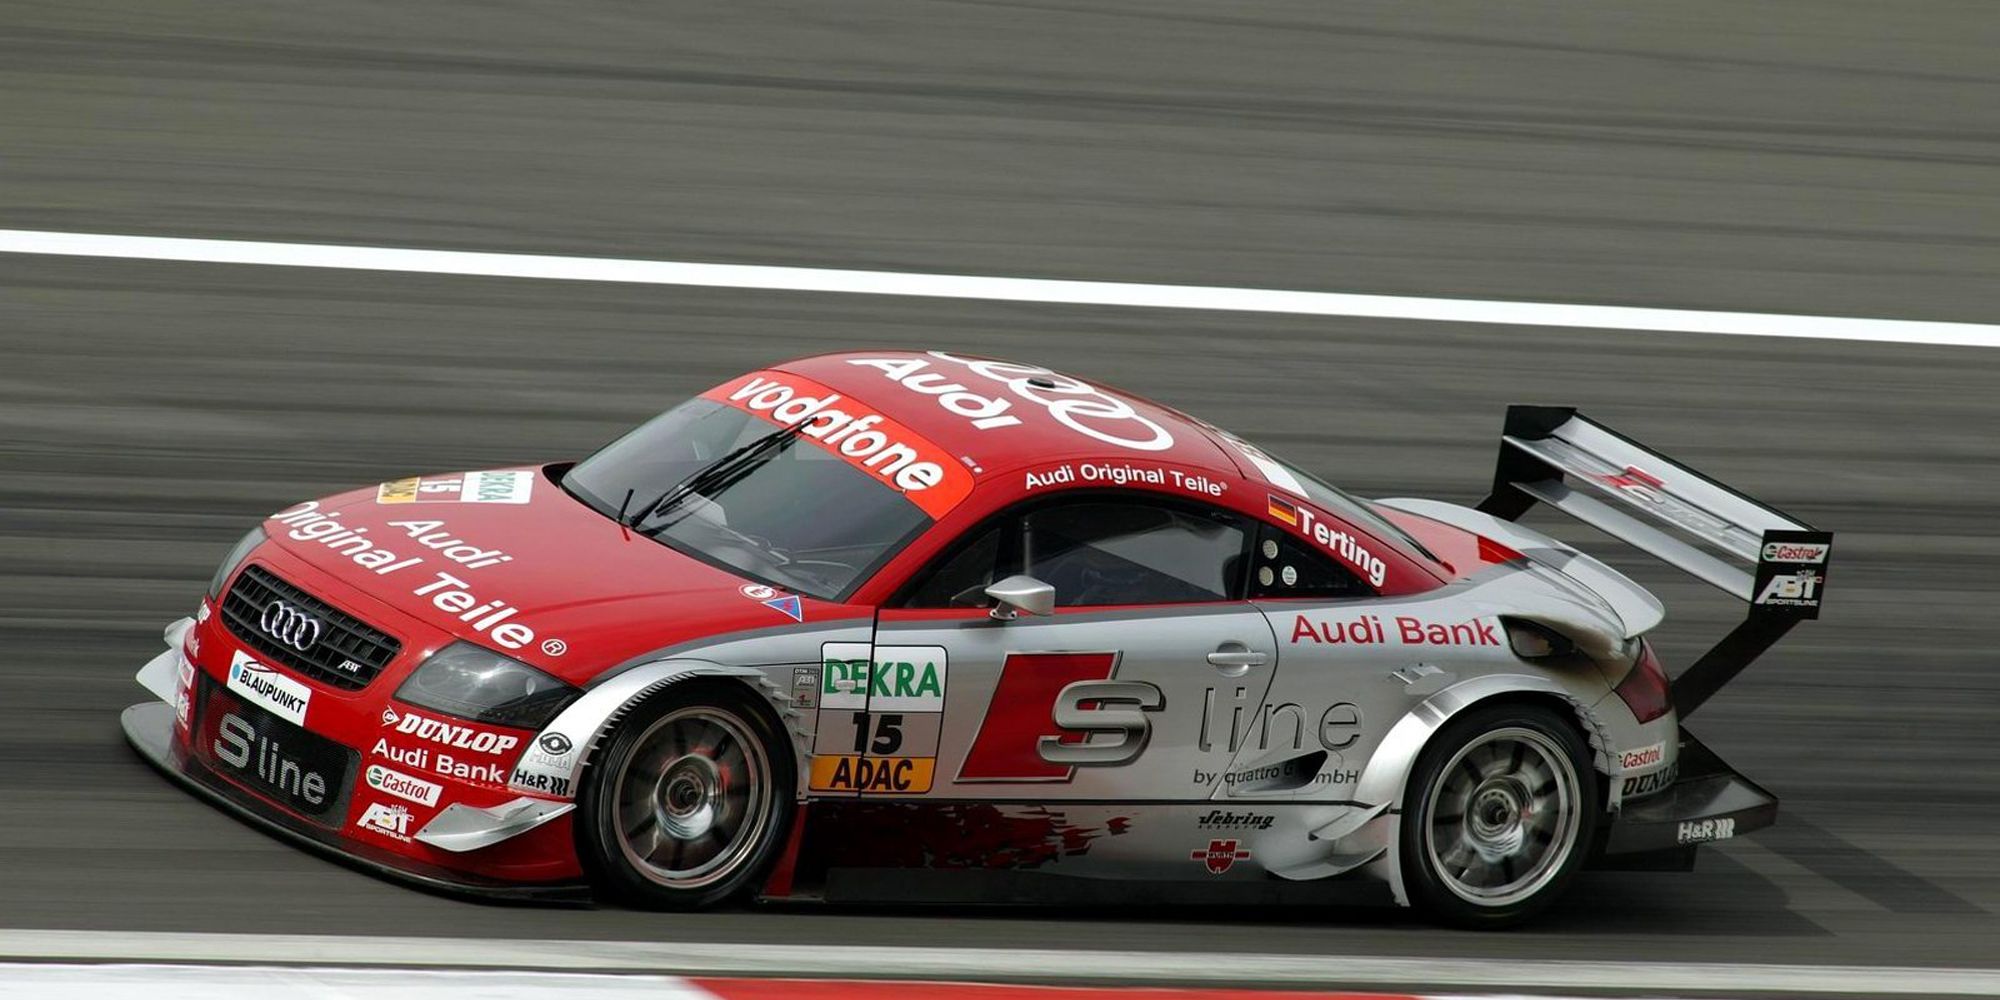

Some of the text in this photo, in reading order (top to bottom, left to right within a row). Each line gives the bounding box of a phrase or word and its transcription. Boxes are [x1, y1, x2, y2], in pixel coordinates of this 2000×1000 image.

[847, 356, 1022, 430] Audi
[729, 376, 944, 492] vodafone
[1025, 464, 1075, 490] Audi
[1081, 464, 1165, 484] Original
[271, 501, 424, 575] Original
[387, 520, 513, 569] Audi
[1297, 506, 1386, 587] Terting
[1291, 615, 1500, 646] Audi Bank
[239, 671, 306, 714] BLAUPUNKT
[824, 658, 941, 698] DEKRA
[396, 712, 518, 755] DUNLOP
[853, 711, 903, 755] 15
[1036, 680, 1363, 767] S line
[214, 713, 326, 805] S line
[371, 738, 429, 769] Audi
[435, 754, 505, 784] Bank
[513, 768, 548, 790] H&R
[829, 757, 913, 791] ADAC
[1193, 769, 1217, 785] by
[1224, 767, 1279, 786] quattro
[381, 771, 431, 802] Castrol
[1678, 819, 1714, 841] H&R
